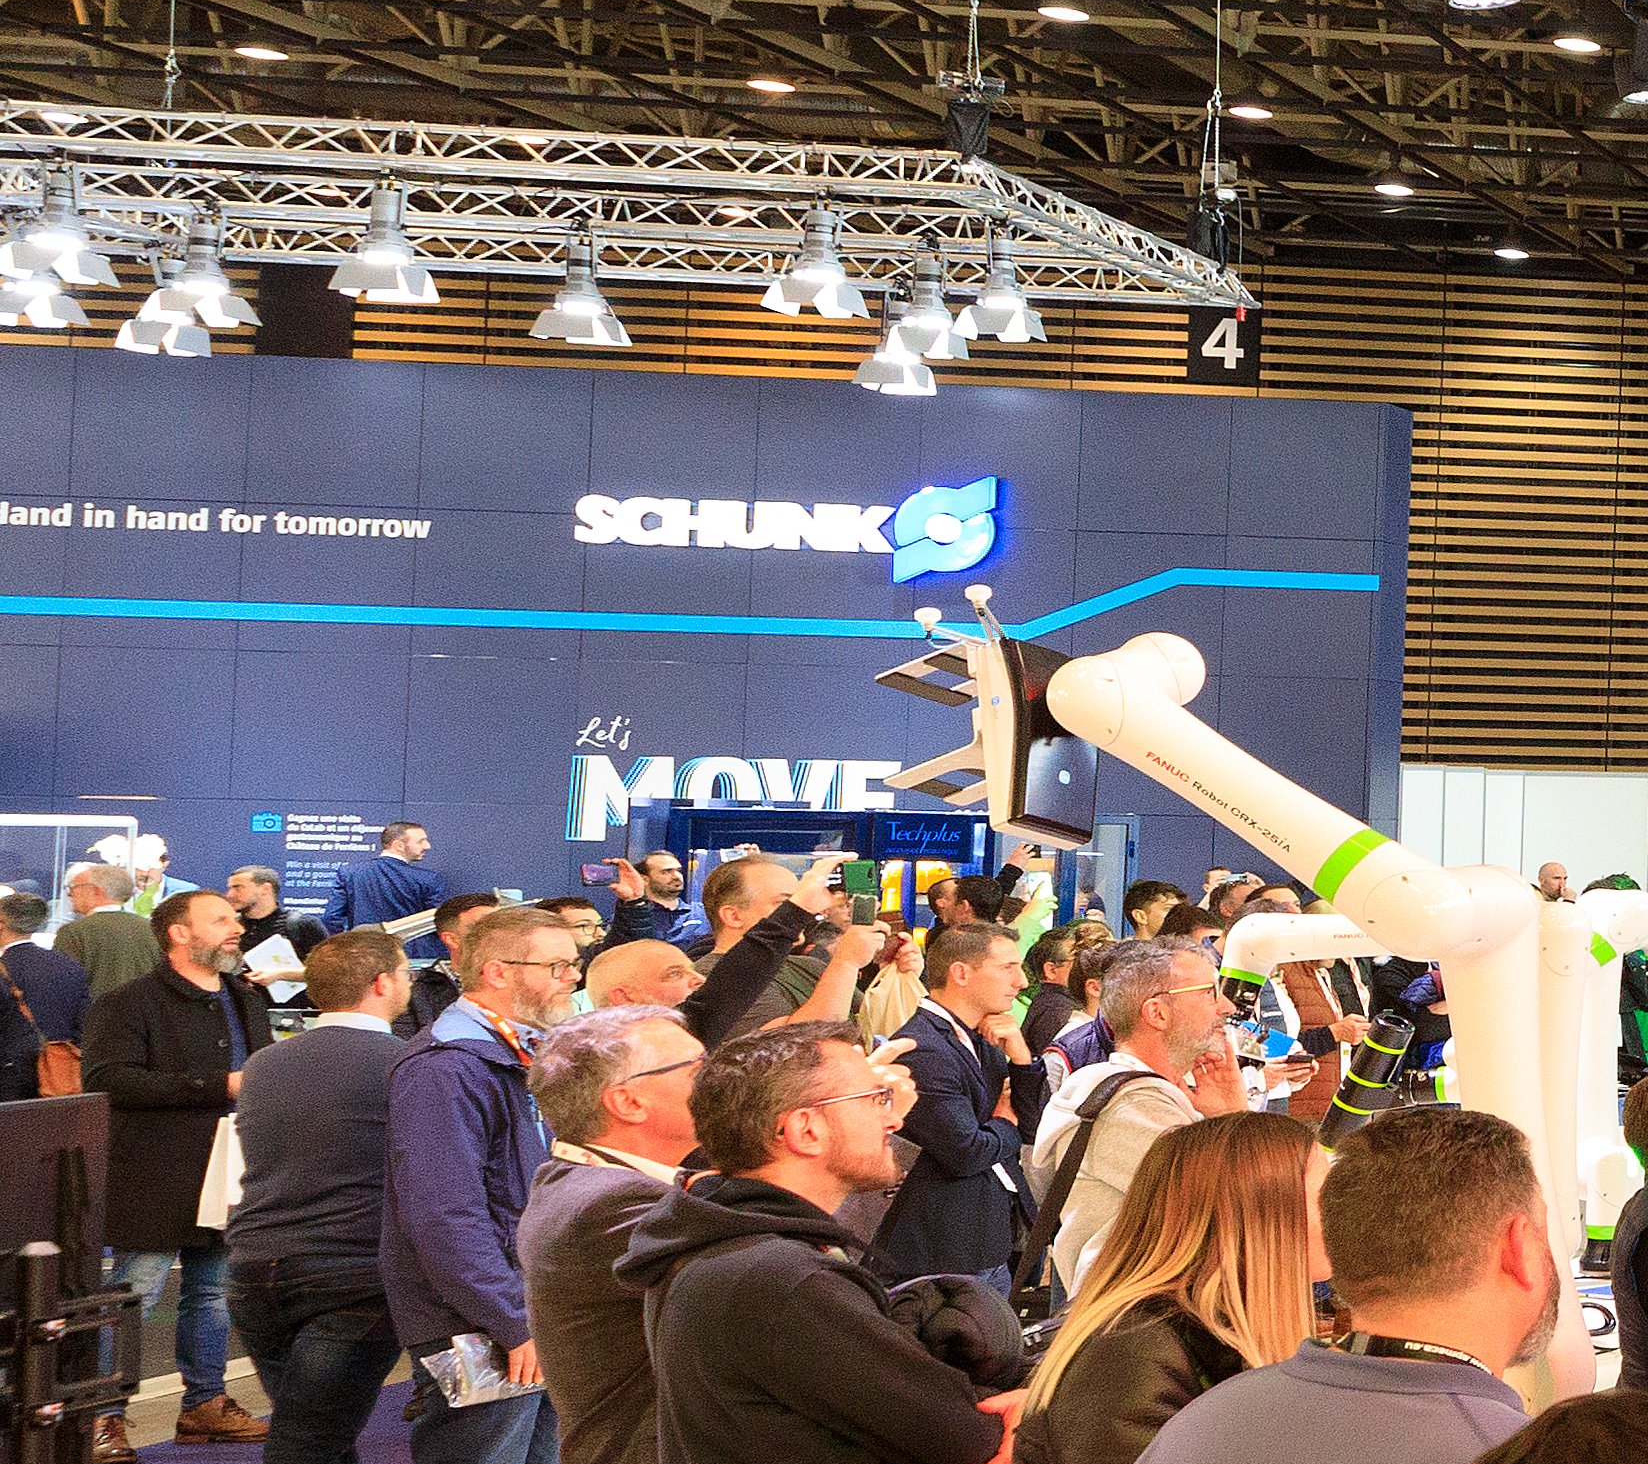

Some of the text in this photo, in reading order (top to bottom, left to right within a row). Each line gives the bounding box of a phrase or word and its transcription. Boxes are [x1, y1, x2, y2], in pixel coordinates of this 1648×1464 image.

[1201, 317, 1244, 369] 4
[83, 503, 115, 529] in
[126, 504, 208, 532] hand
[219, 508, 267, 534] for
[273, 511, 432, 539] tomorrow
[574, 494, 896, 553] SCHUNK
[576, 716, 630, 751] Let's
[565, 755, 902, 841] MOVE
[1146, 751, 1189, 782] FANUC
[1192, 780, 1229, 810] Robot
[886, 820, 961, 853] Techplus
